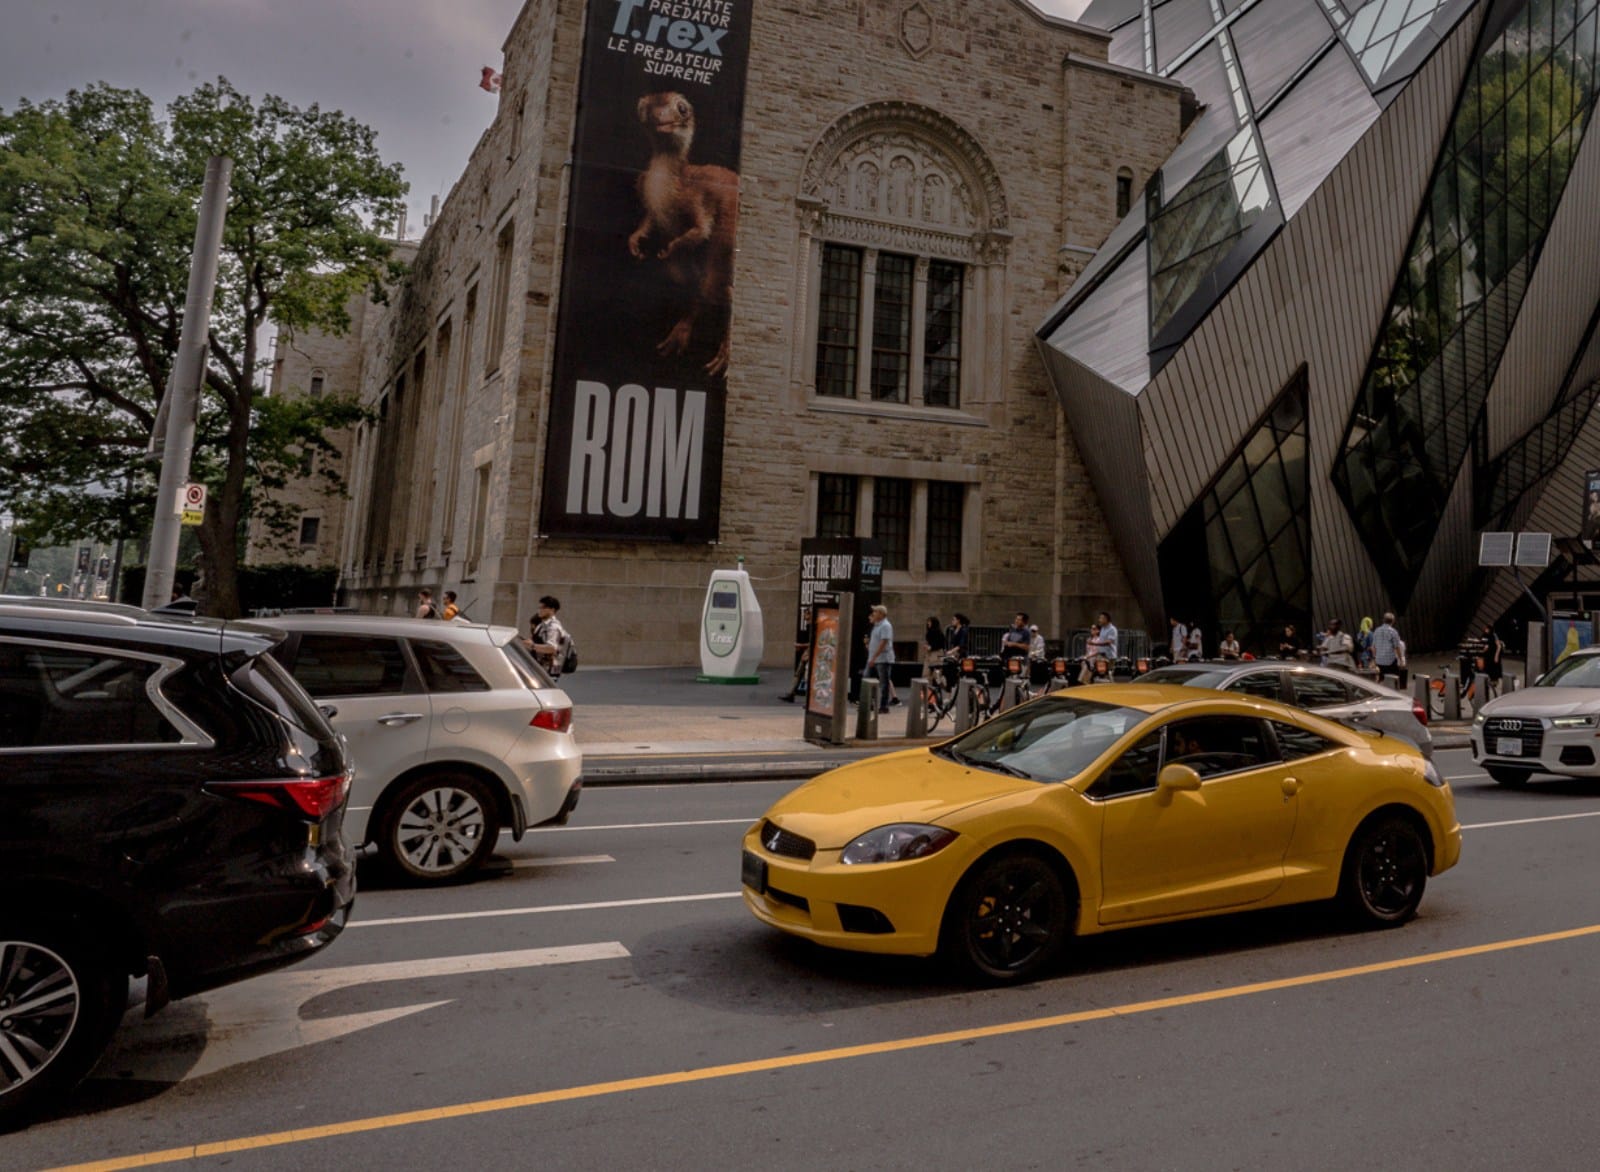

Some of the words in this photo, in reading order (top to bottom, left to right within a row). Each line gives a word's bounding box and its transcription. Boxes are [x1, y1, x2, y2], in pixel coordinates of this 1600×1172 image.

[649, 0, 731, 27] PREDATOR
[667, 0, 733, 15] IMATE
[612, 0, 728, 56] T.rex
[607, 37, 629, 52] LE
[633, 43, 722, 72] PRÉDATEUR
[644, 60, 714, 85] SUPRÊME
[566, 380, 707, 520] ROM
[802, 555, 815, 579] SEE
[816, 555, 830, 579] THE
[831, 555, 853, 579] BABY
